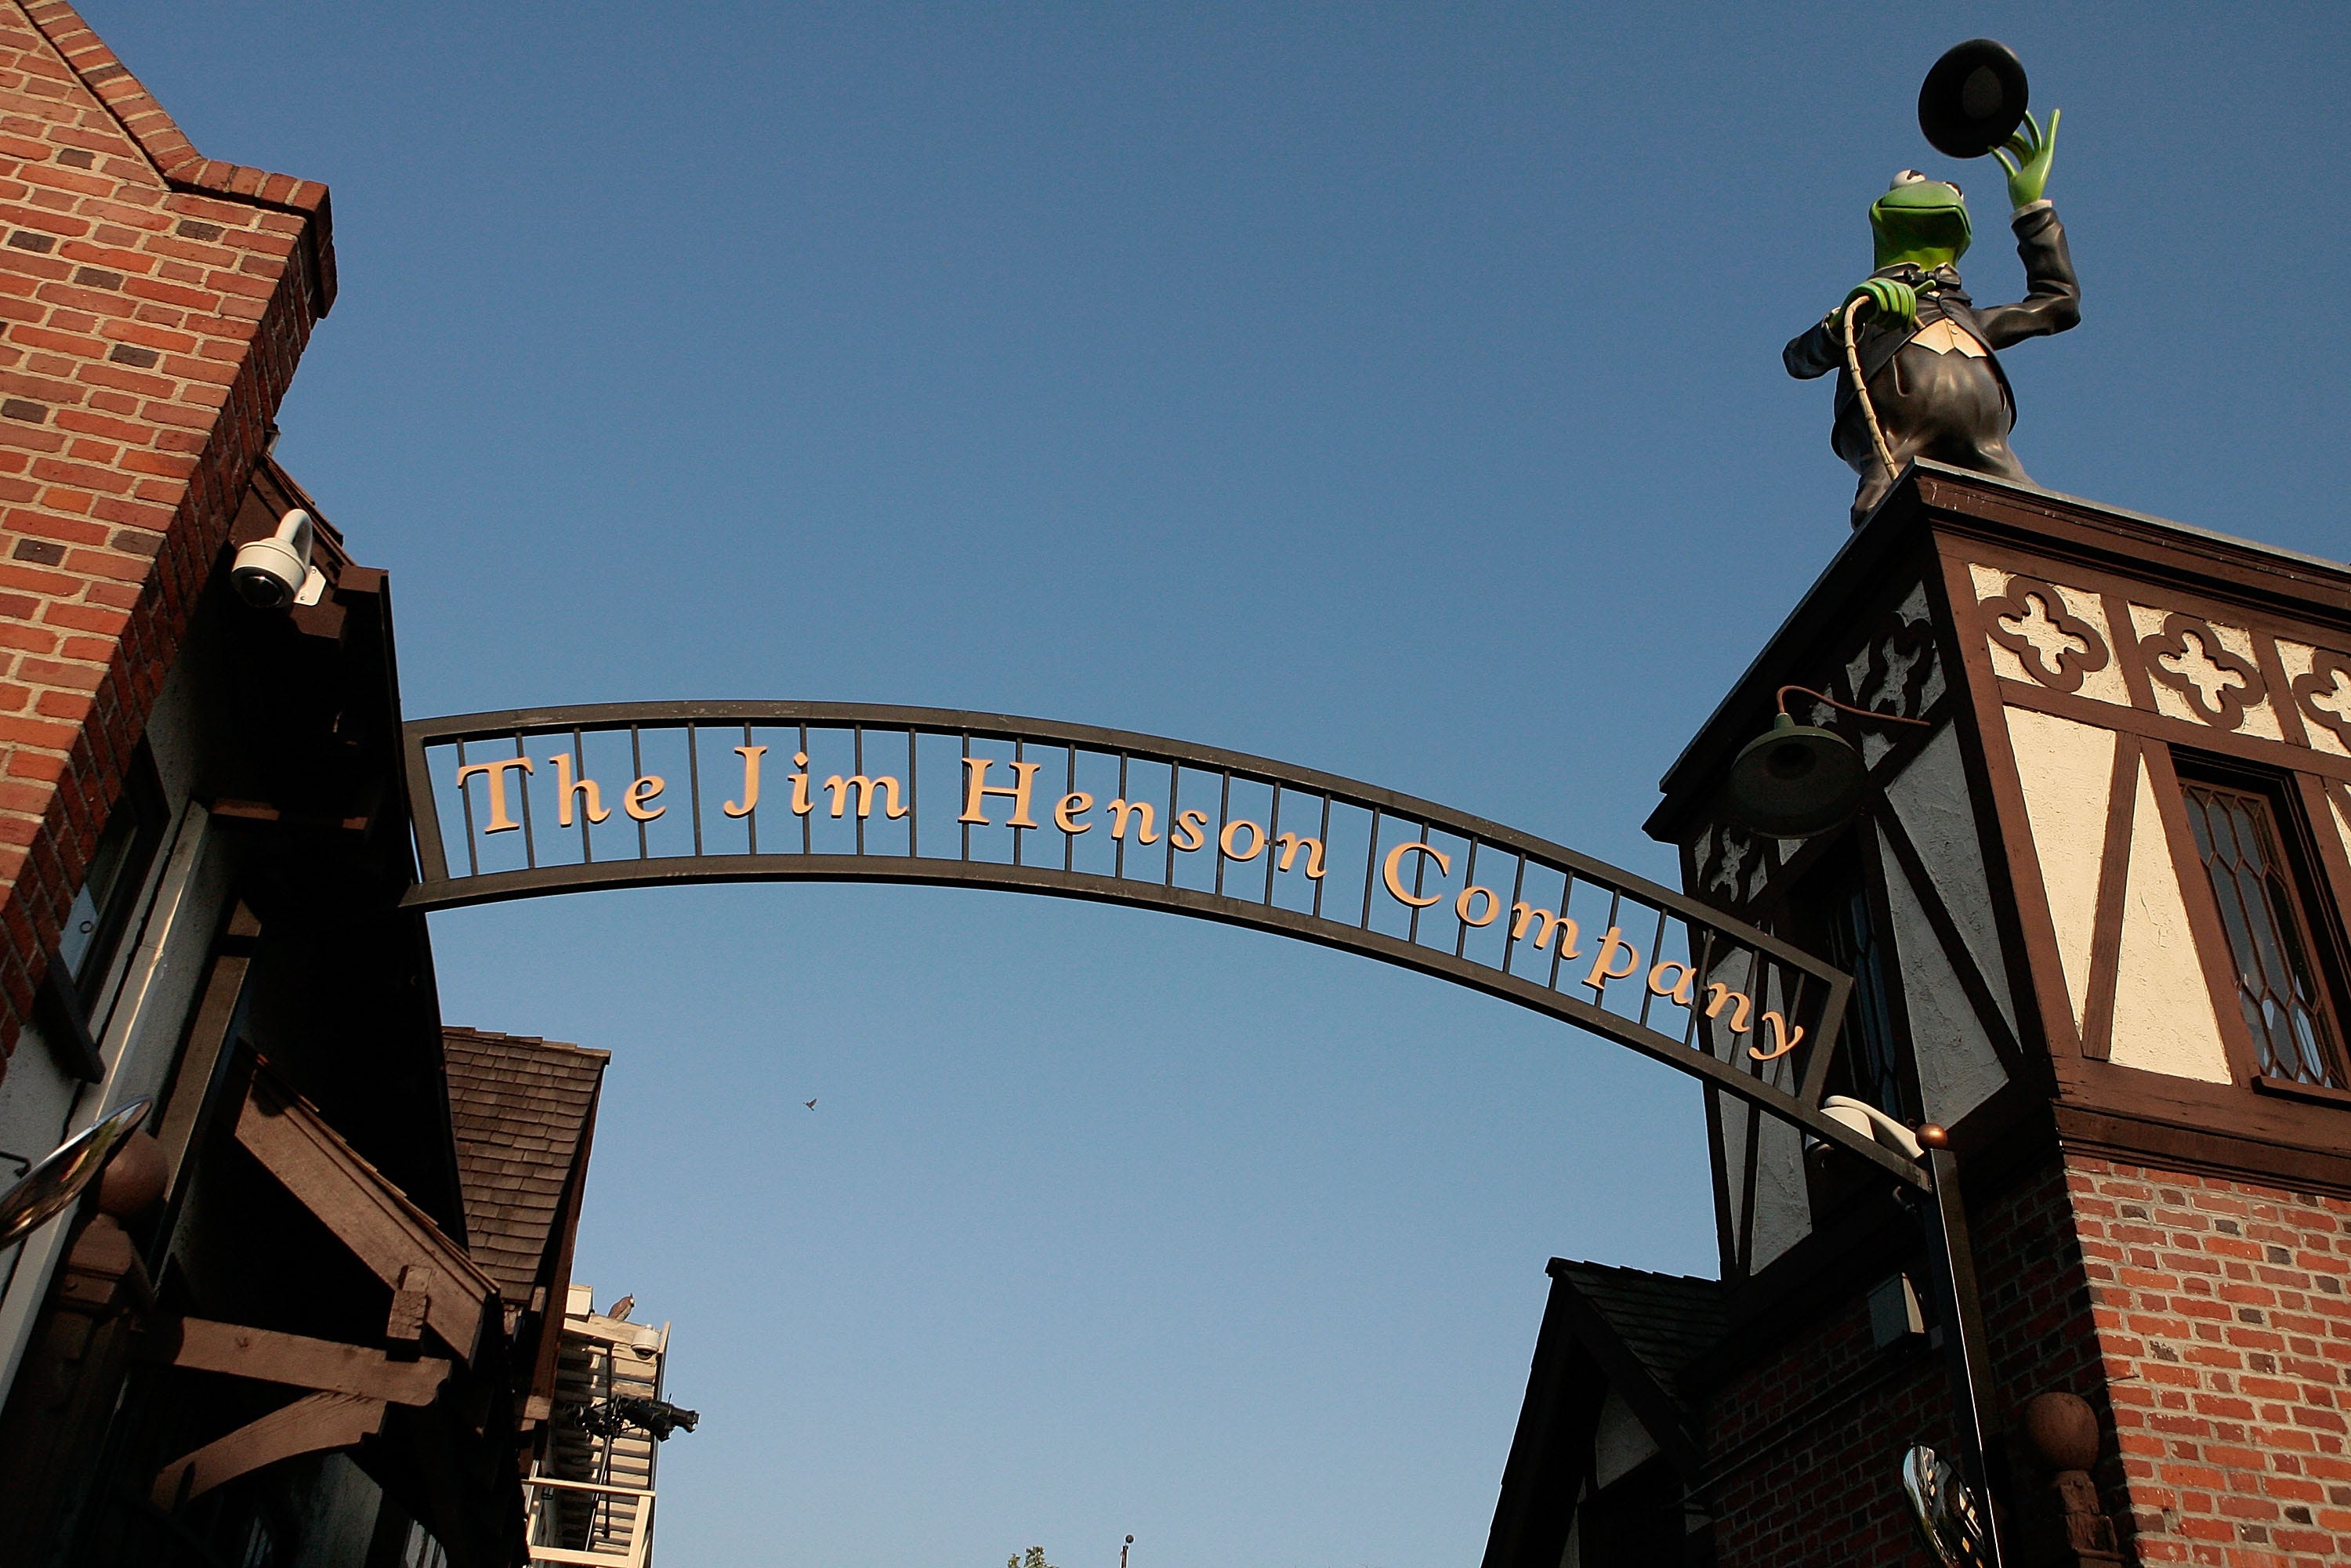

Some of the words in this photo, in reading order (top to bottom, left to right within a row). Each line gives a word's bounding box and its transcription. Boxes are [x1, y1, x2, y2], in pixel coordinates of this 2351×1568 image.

[457, 752, 666, 833] The
[723, 745, 909, 818] Jim
[958, 756, 1327, 878] Henson
[1383, 841, 1805, 1061] Company
